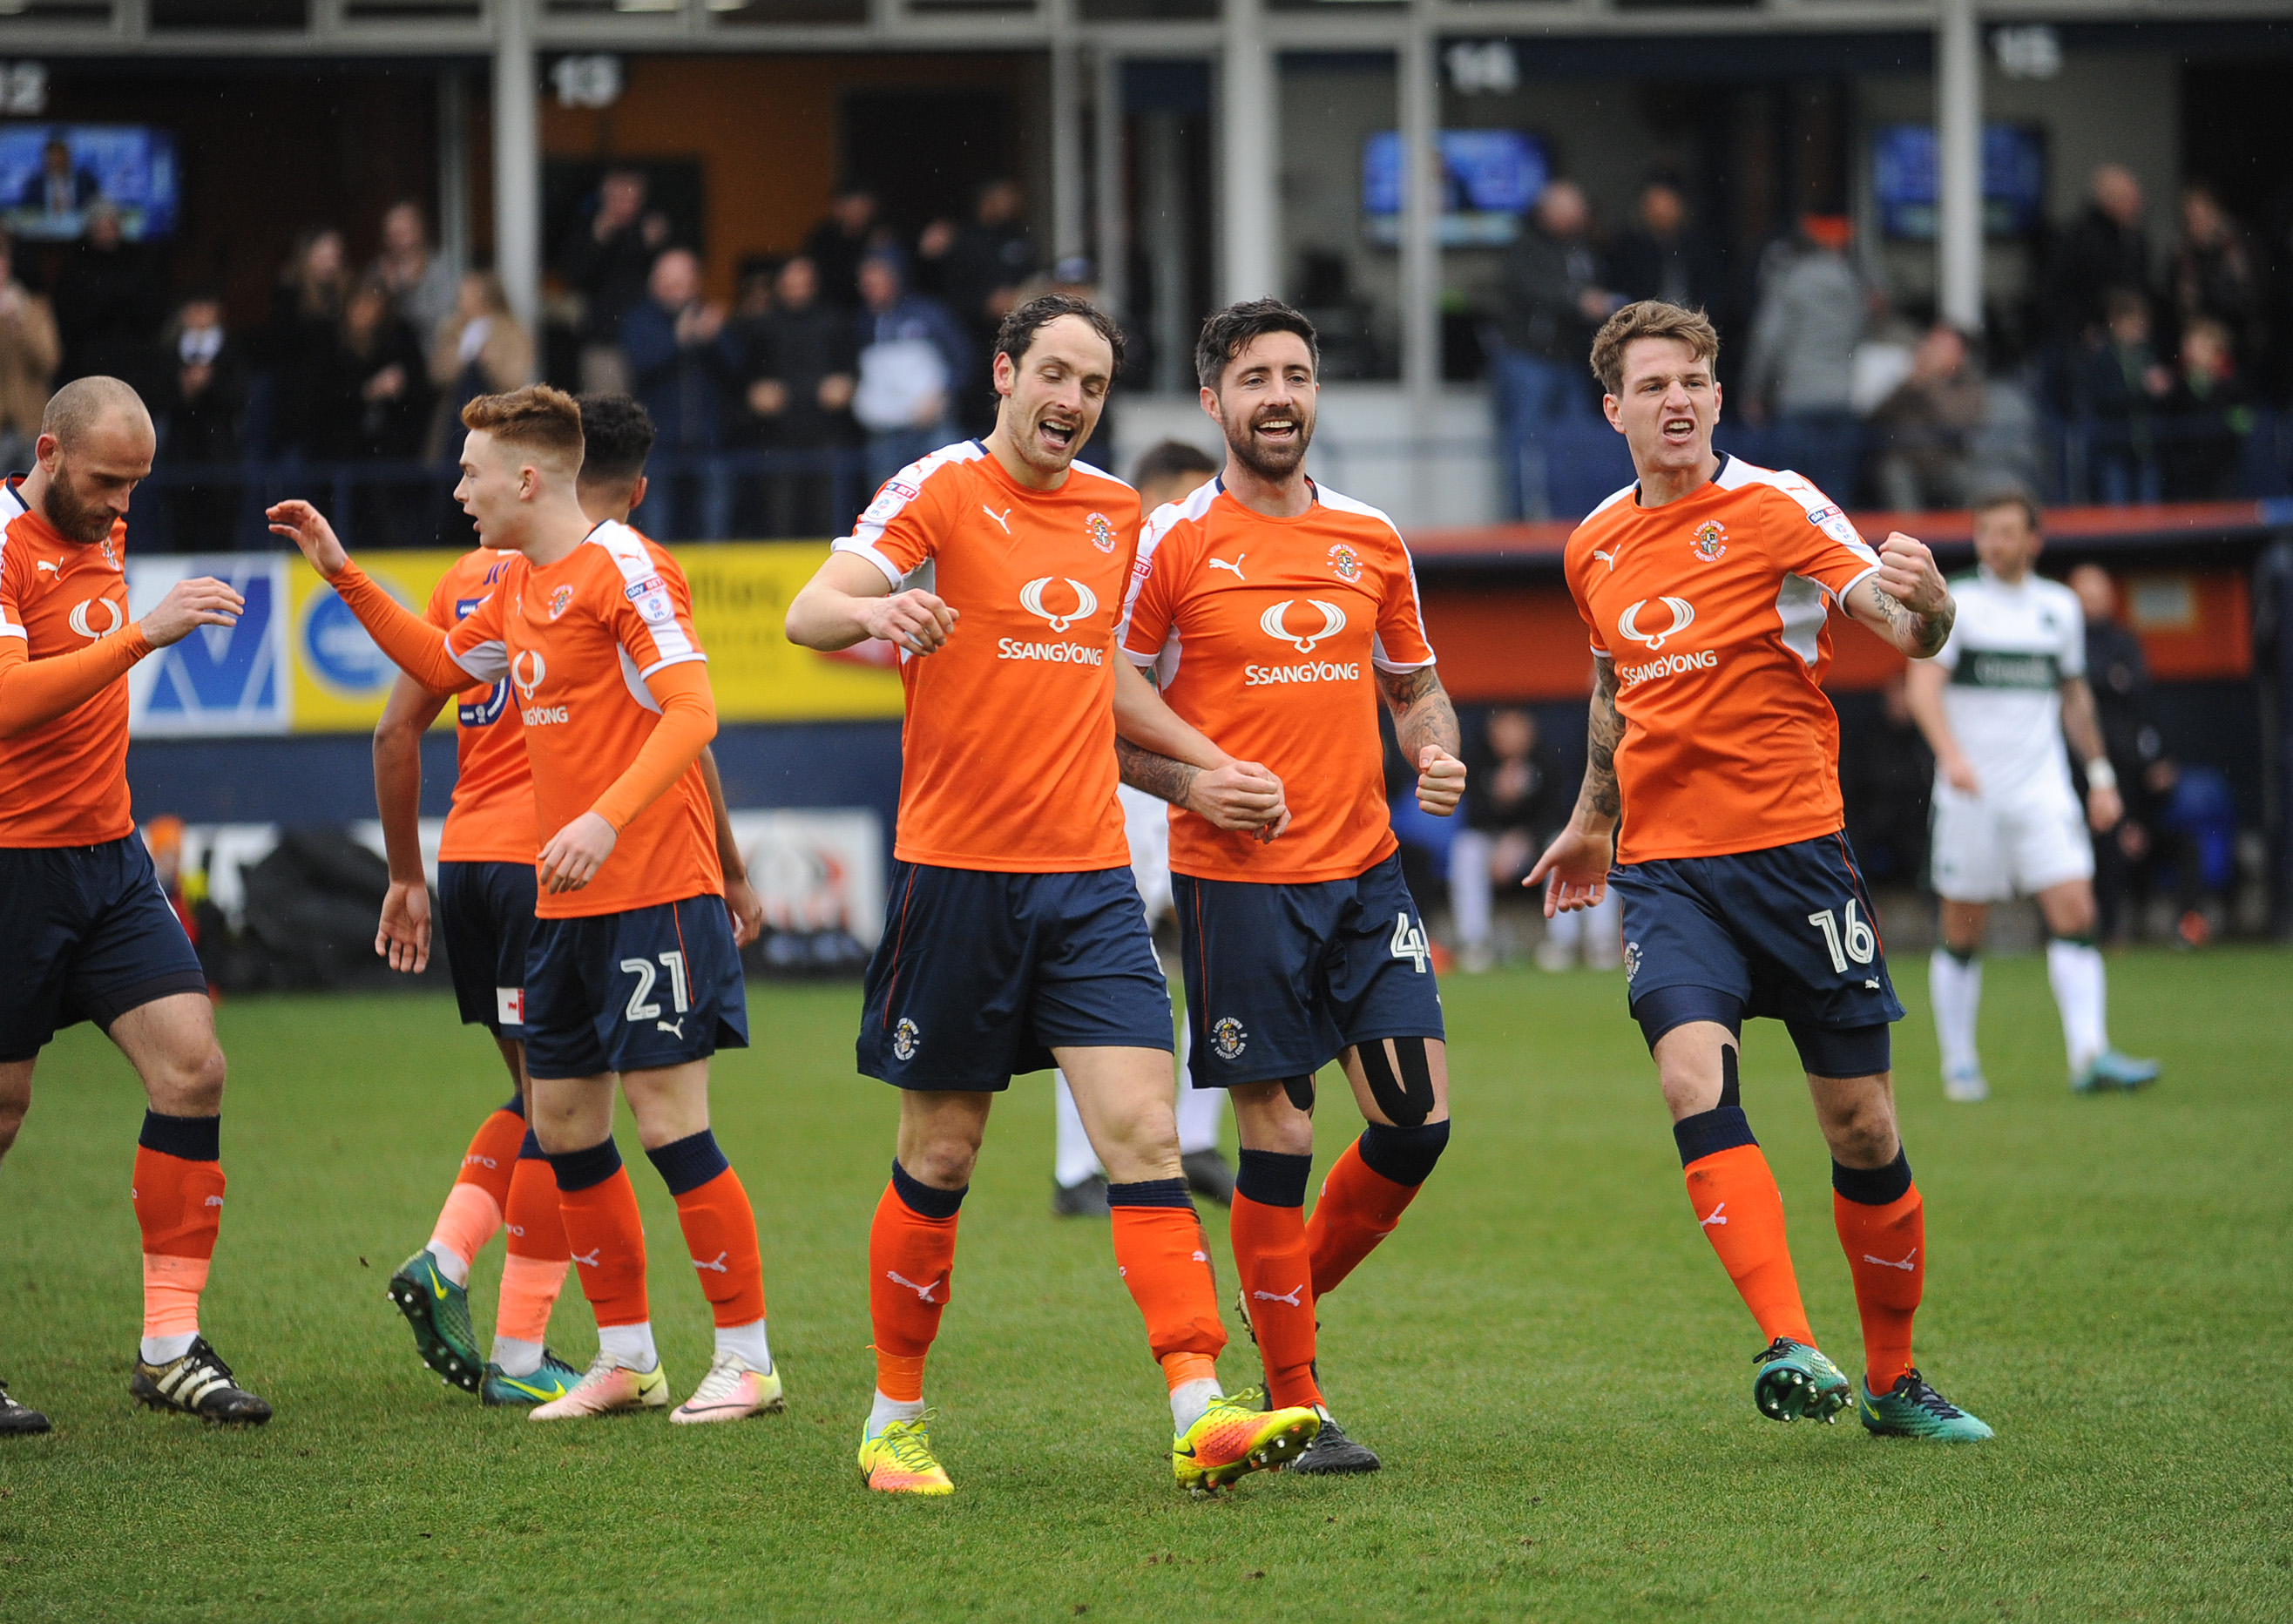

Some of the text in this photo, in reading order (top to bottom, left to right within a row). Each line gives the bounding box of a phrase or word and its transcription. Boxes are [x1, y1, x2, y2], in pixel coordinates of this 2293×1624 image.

[627, 585, 646, 599] sky
[1807, 897, 1875, 973] 16
[619, 950, 688, 1022] 21
